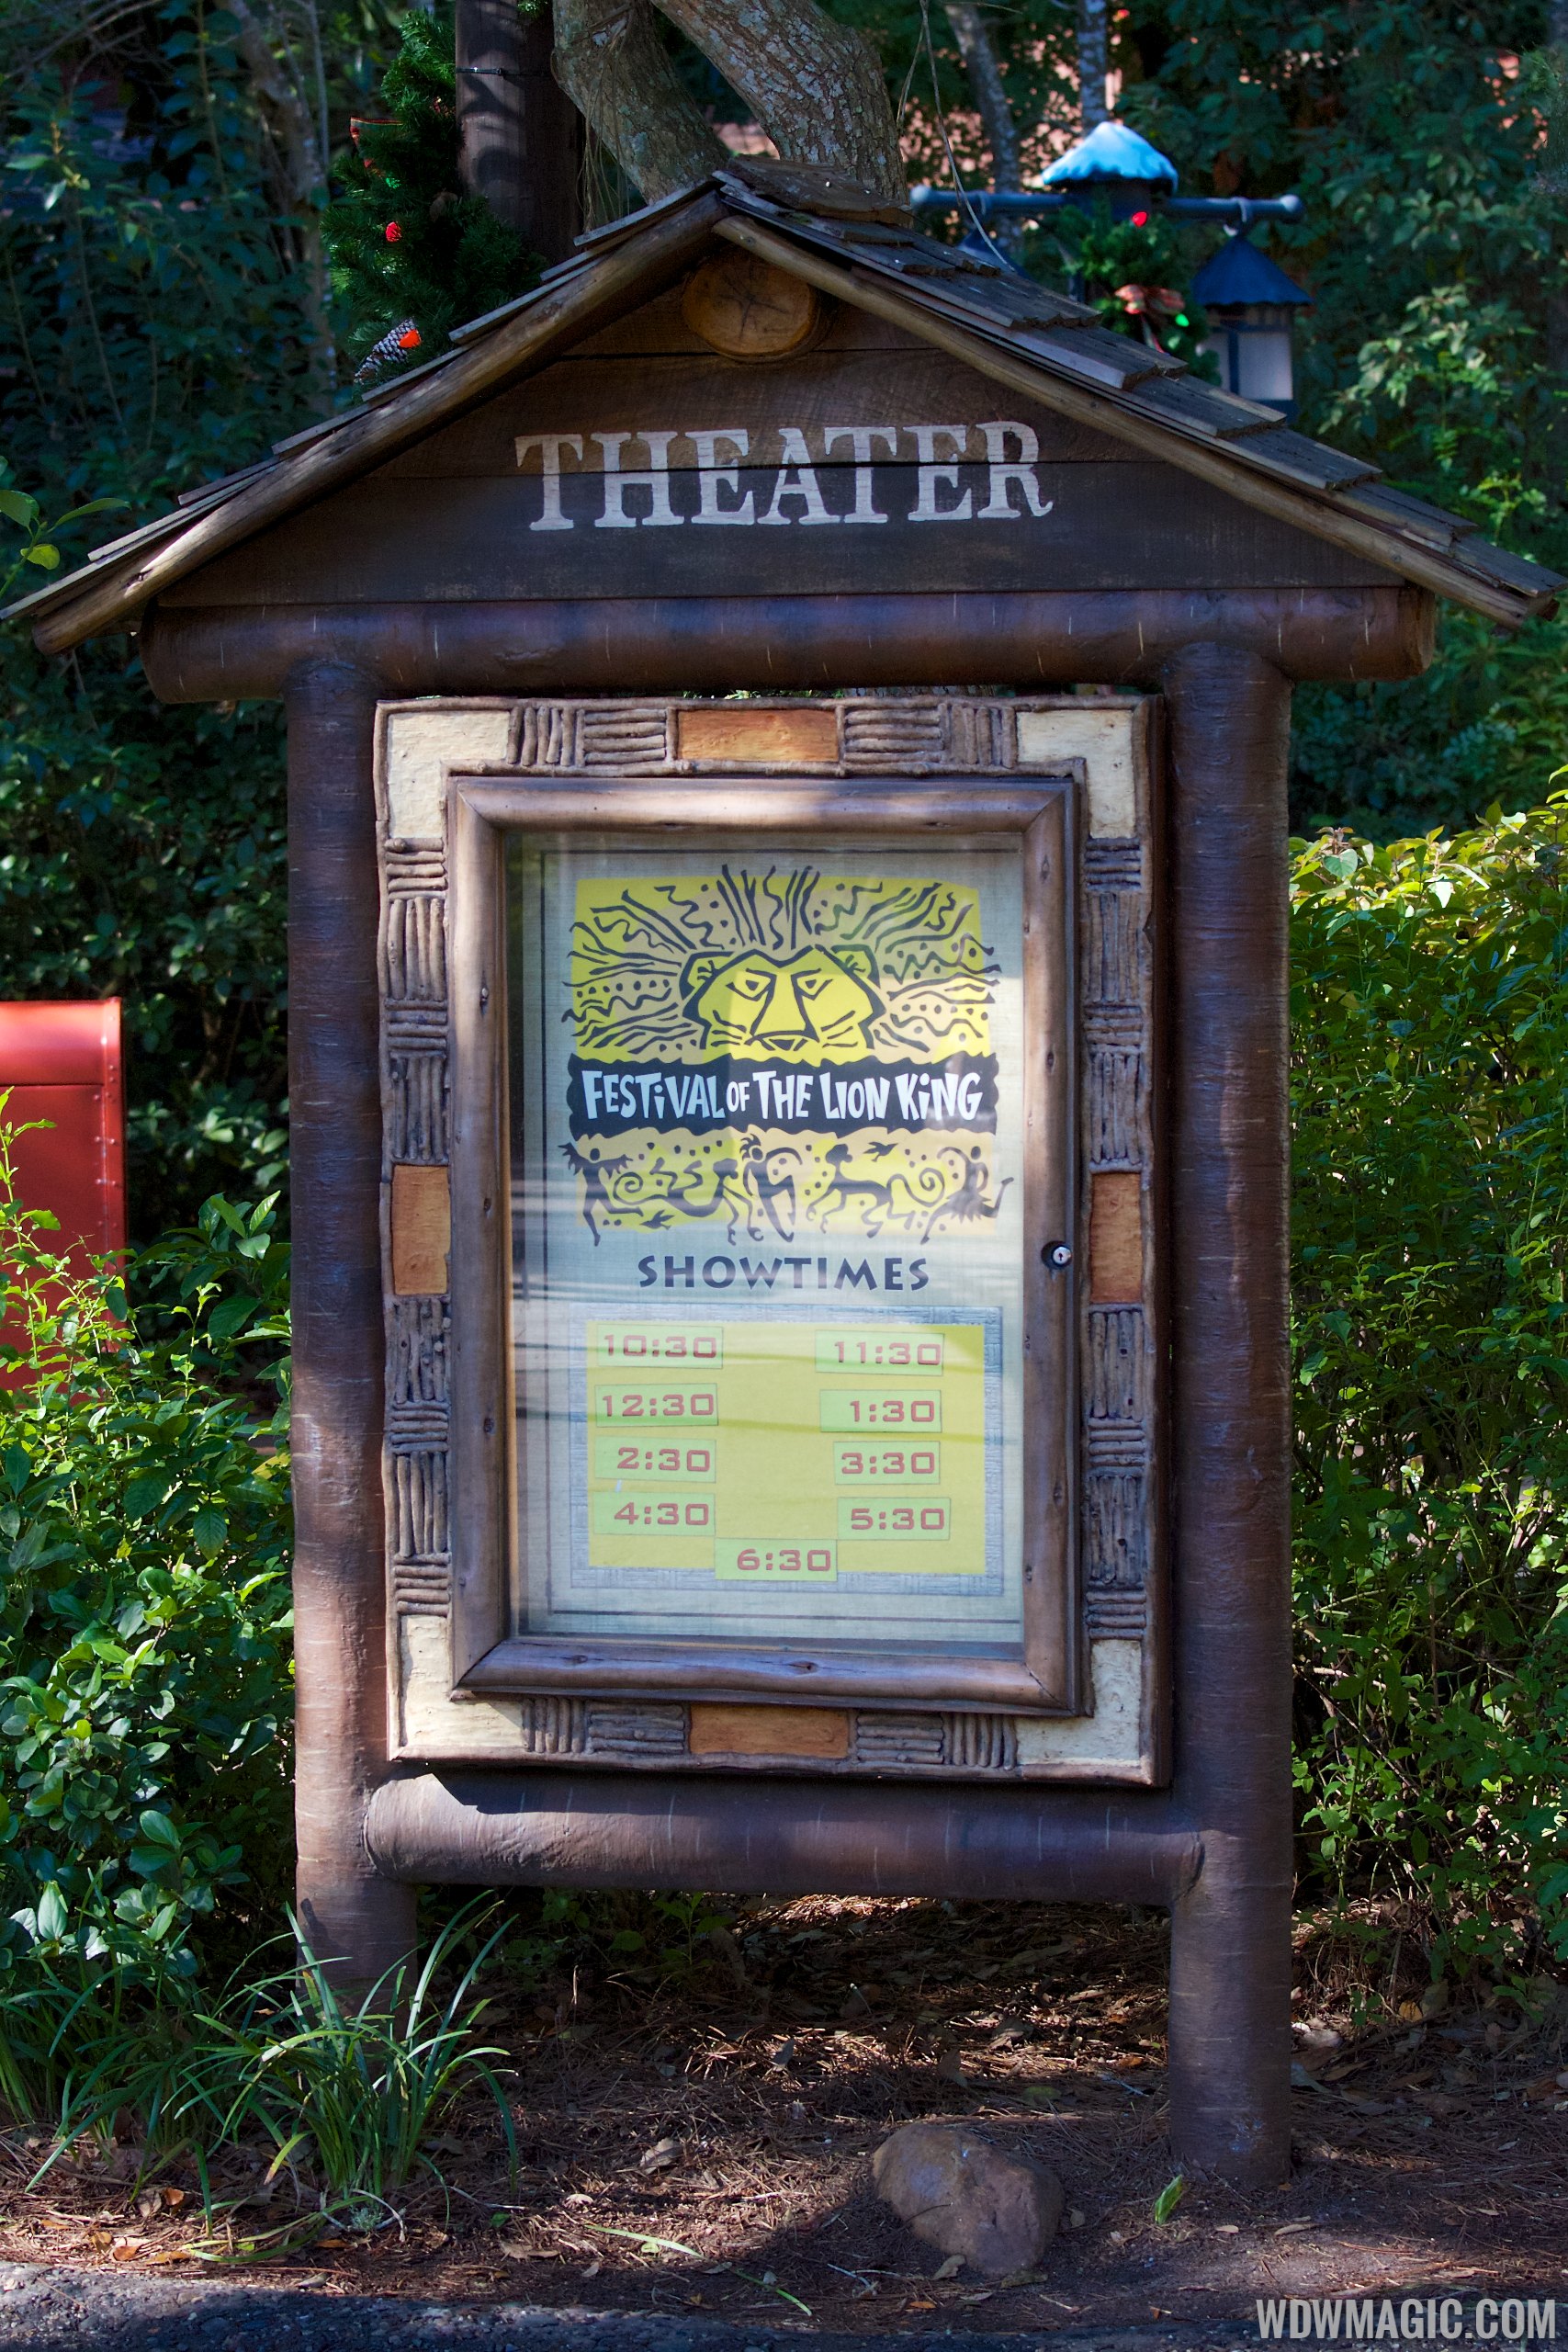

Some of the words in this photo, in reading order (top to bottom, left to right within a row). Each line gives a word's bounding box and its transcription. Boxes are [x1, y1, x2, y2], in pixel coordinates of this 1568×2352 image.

[514, 421, 1054, 530] THEATER
[726, 1081, 750, 1112] OF
[752, 1070, 813, 1120] THE
[820, 1072, 890, 1122] LION
[638, 1254, 930, 1291] SHOWTIMES
[604, 1334, 717, 1359] 10:30
[834, 1340, 941, 1366] 11:30
[602, 1393, 714, 1417] 12:30
[850, 1400, 935, 1423] 1:30
[617, 1446, 710, 1473] 2:30
[840, 1452, 935, 1475] 3:30
[614, 1501, 709, 1526] 4:30
[851, 1508, 945, 1531] 5:30
[737, 1548, 831, 1572] 6:30
